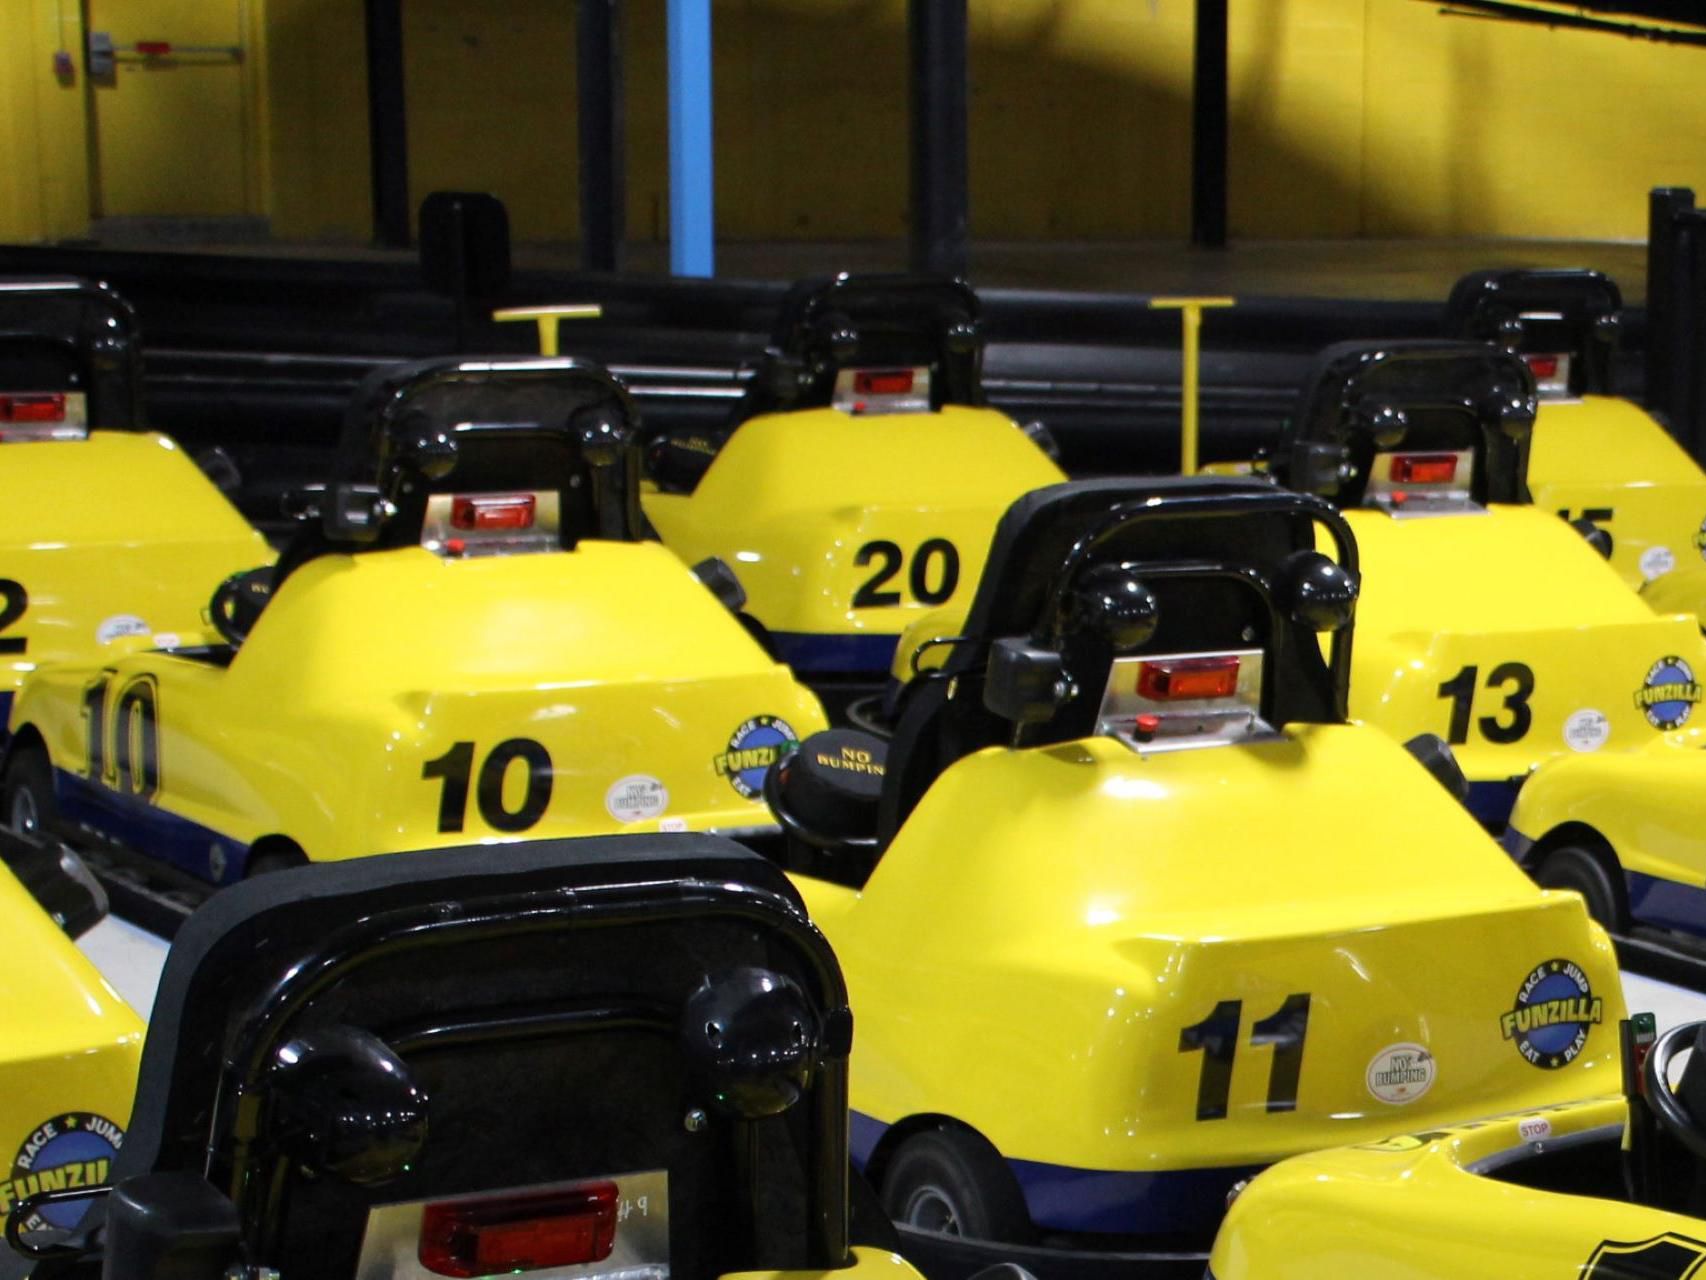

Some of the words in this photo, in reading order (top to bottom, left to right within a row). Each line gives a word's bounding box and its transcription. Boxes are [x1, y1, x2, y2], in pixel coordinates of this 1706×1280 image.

[1557, 508, 1614, 560] 5
[853, 537, 960, 609] 20
[1438, 662, 1535, 745] 13
[80, 667, 163, 806] 10
[841, 747, 871, 764] NO
[713, 747, 776, 776] FUNZI
[817, 753, 886, 776] BUMPIN
[423, 737, 553, 834] 10
[1519, 966, 1547, 1004] RACE
[1563, 963, 1589, 993] JUMP
[1500, 997, 1602, 1040] FUNZILLA
[1178, 993, 1311, 1121] 11
[1519, 1040, 1541, 1064] EAT
[1564, 1029, 1587, 1062] PLAY
[17, 1122, 58, 1170] RACE
[85, 1117, 123, 1150] JUM
[1520, 1122, 1548, 1137] STOP
